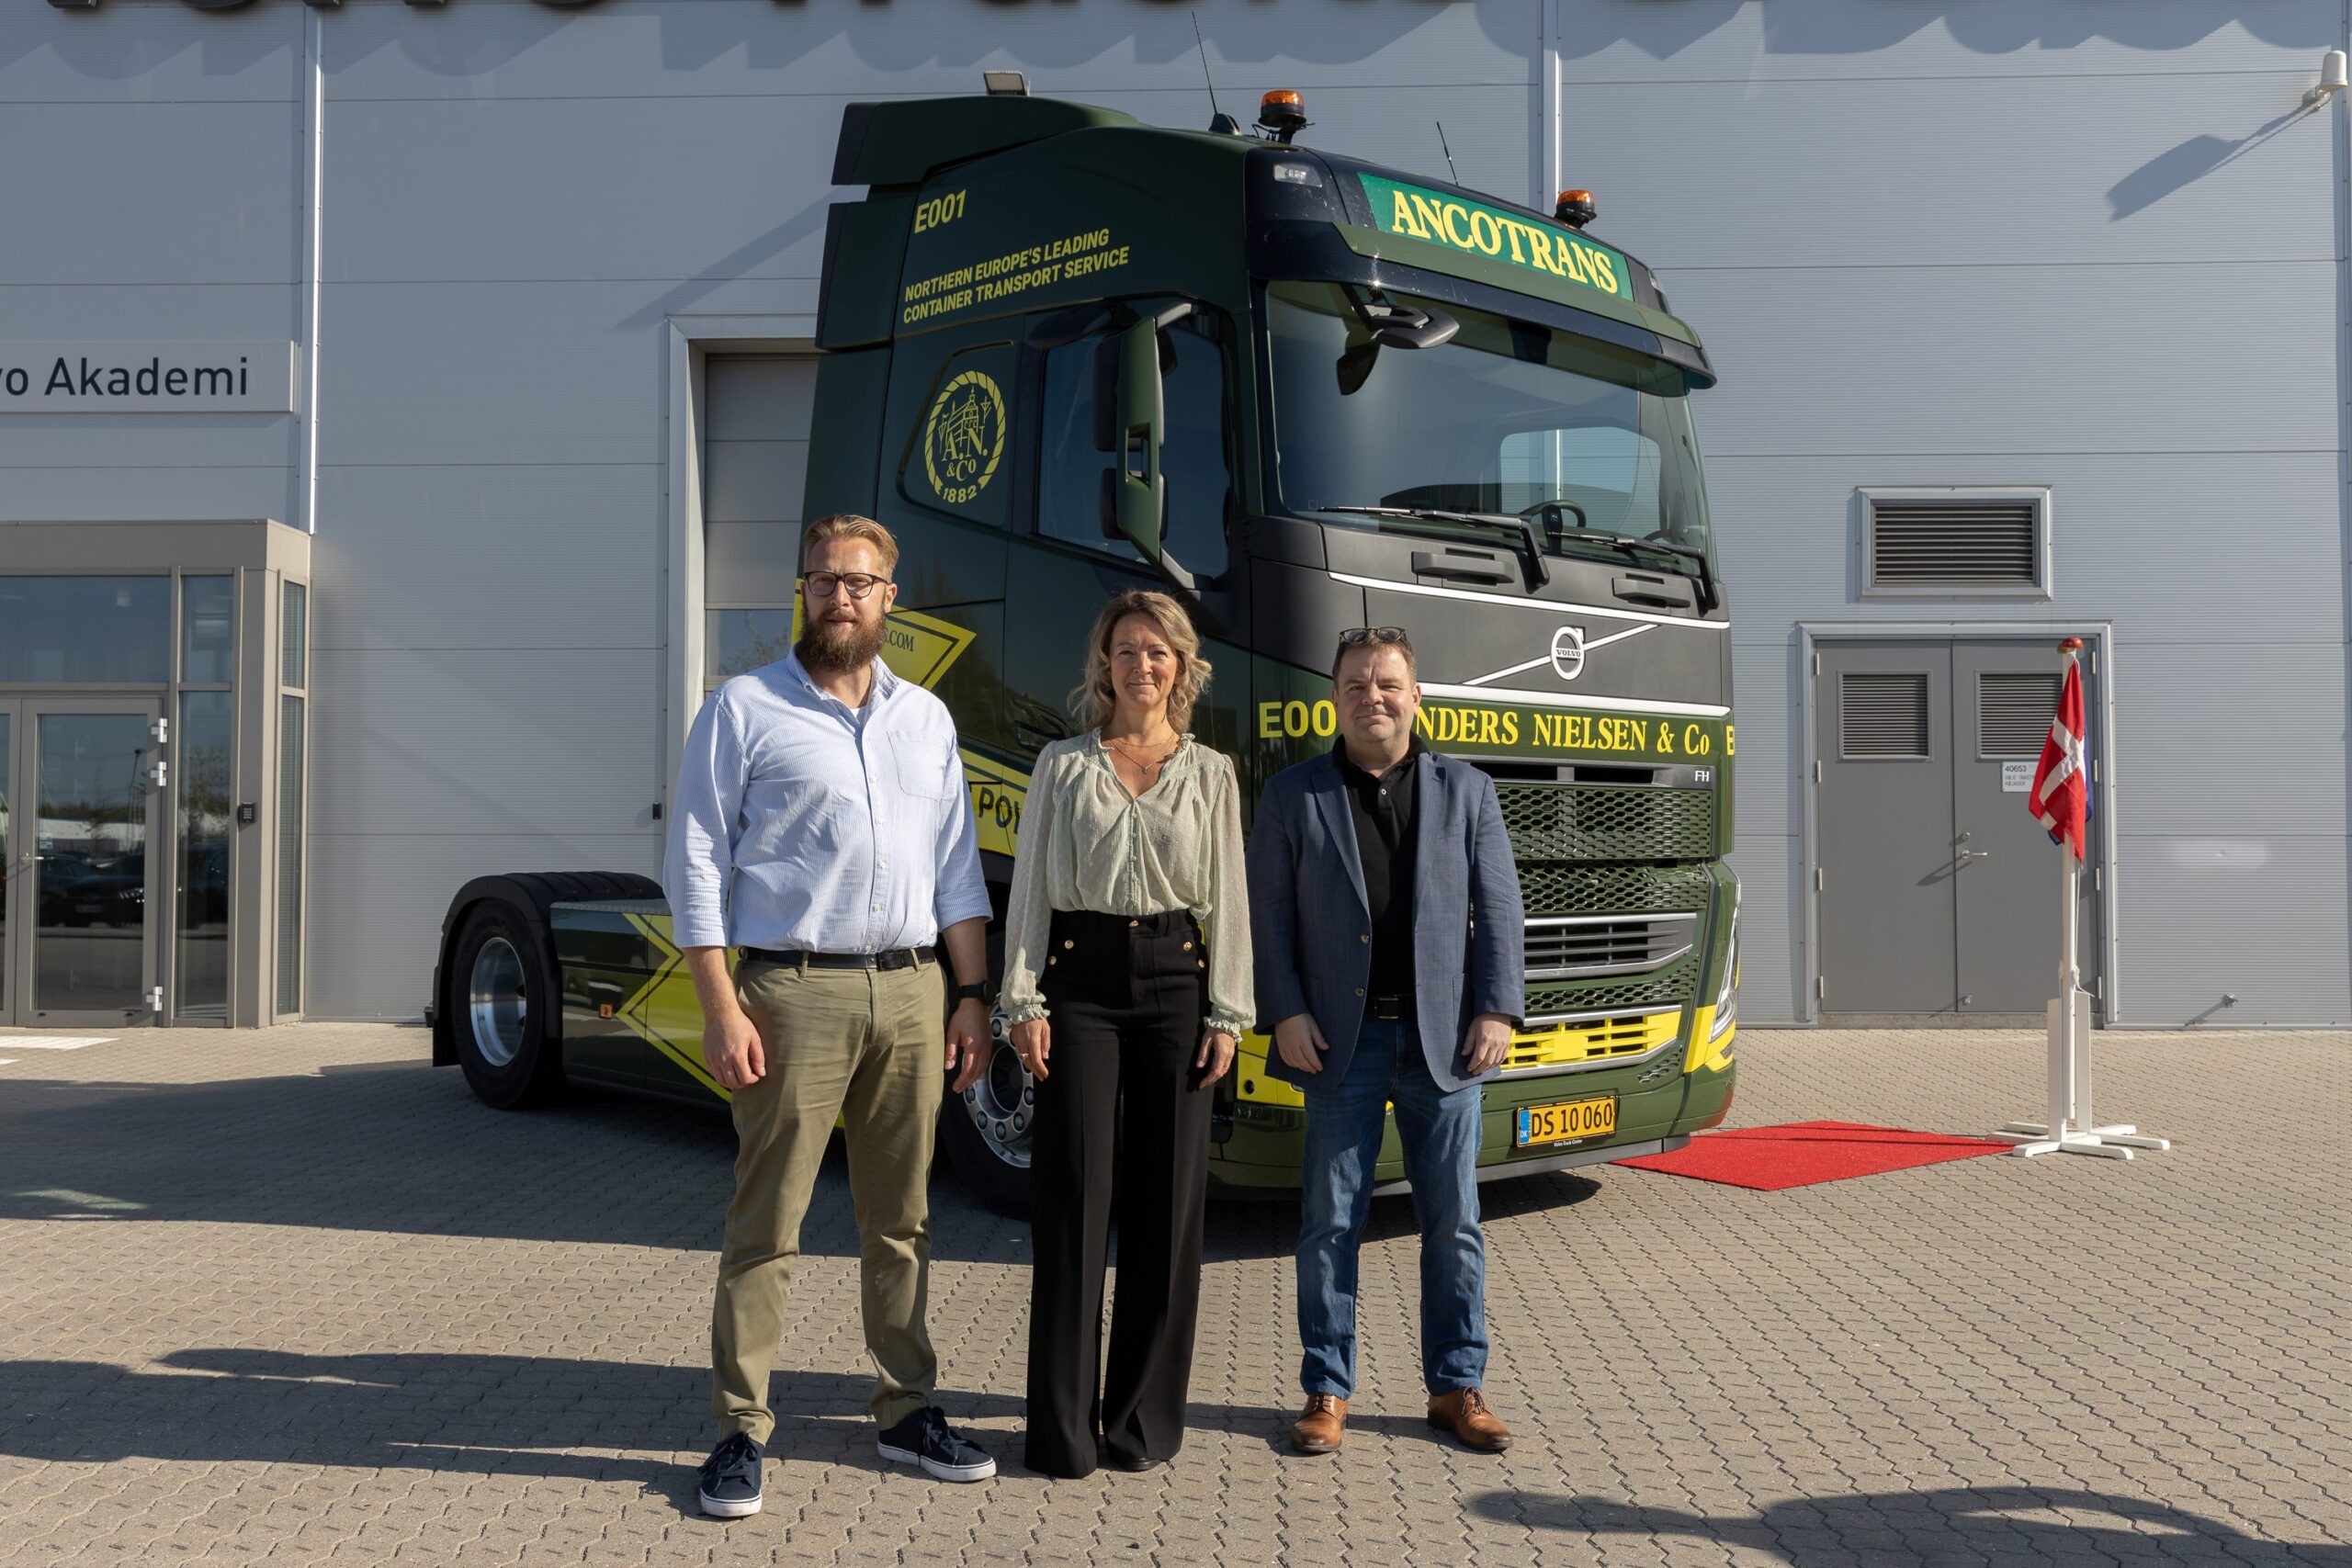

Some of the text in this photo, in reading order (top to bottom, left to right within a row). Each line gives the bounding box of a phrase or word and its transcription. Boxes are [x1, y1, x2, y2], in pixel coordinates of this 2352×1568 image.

[914, 189, 967, 234] E001
[1392, 189, 1619, 294] ANCOTRANS
[903, 245, 1130, 324] CONTAINER TRANSPORT SERVICE
[905, 228, 1110, 302] NORTHERN EUROPE'S LEADING
[0, 356, 247, 396] o Akademi
[943, 484, 978, 504] 1882
[1556, 649, 1581, 658] VOLVO
[1532, 713, 1647, 751] NIELSEN
[1657, 721, 1675, 753] &
[1694, 770, 1710, 782] FH
[2005, 764, 2027, 773] 40653
[1521, 1102, 1613, 1138] DK DS 10 060
